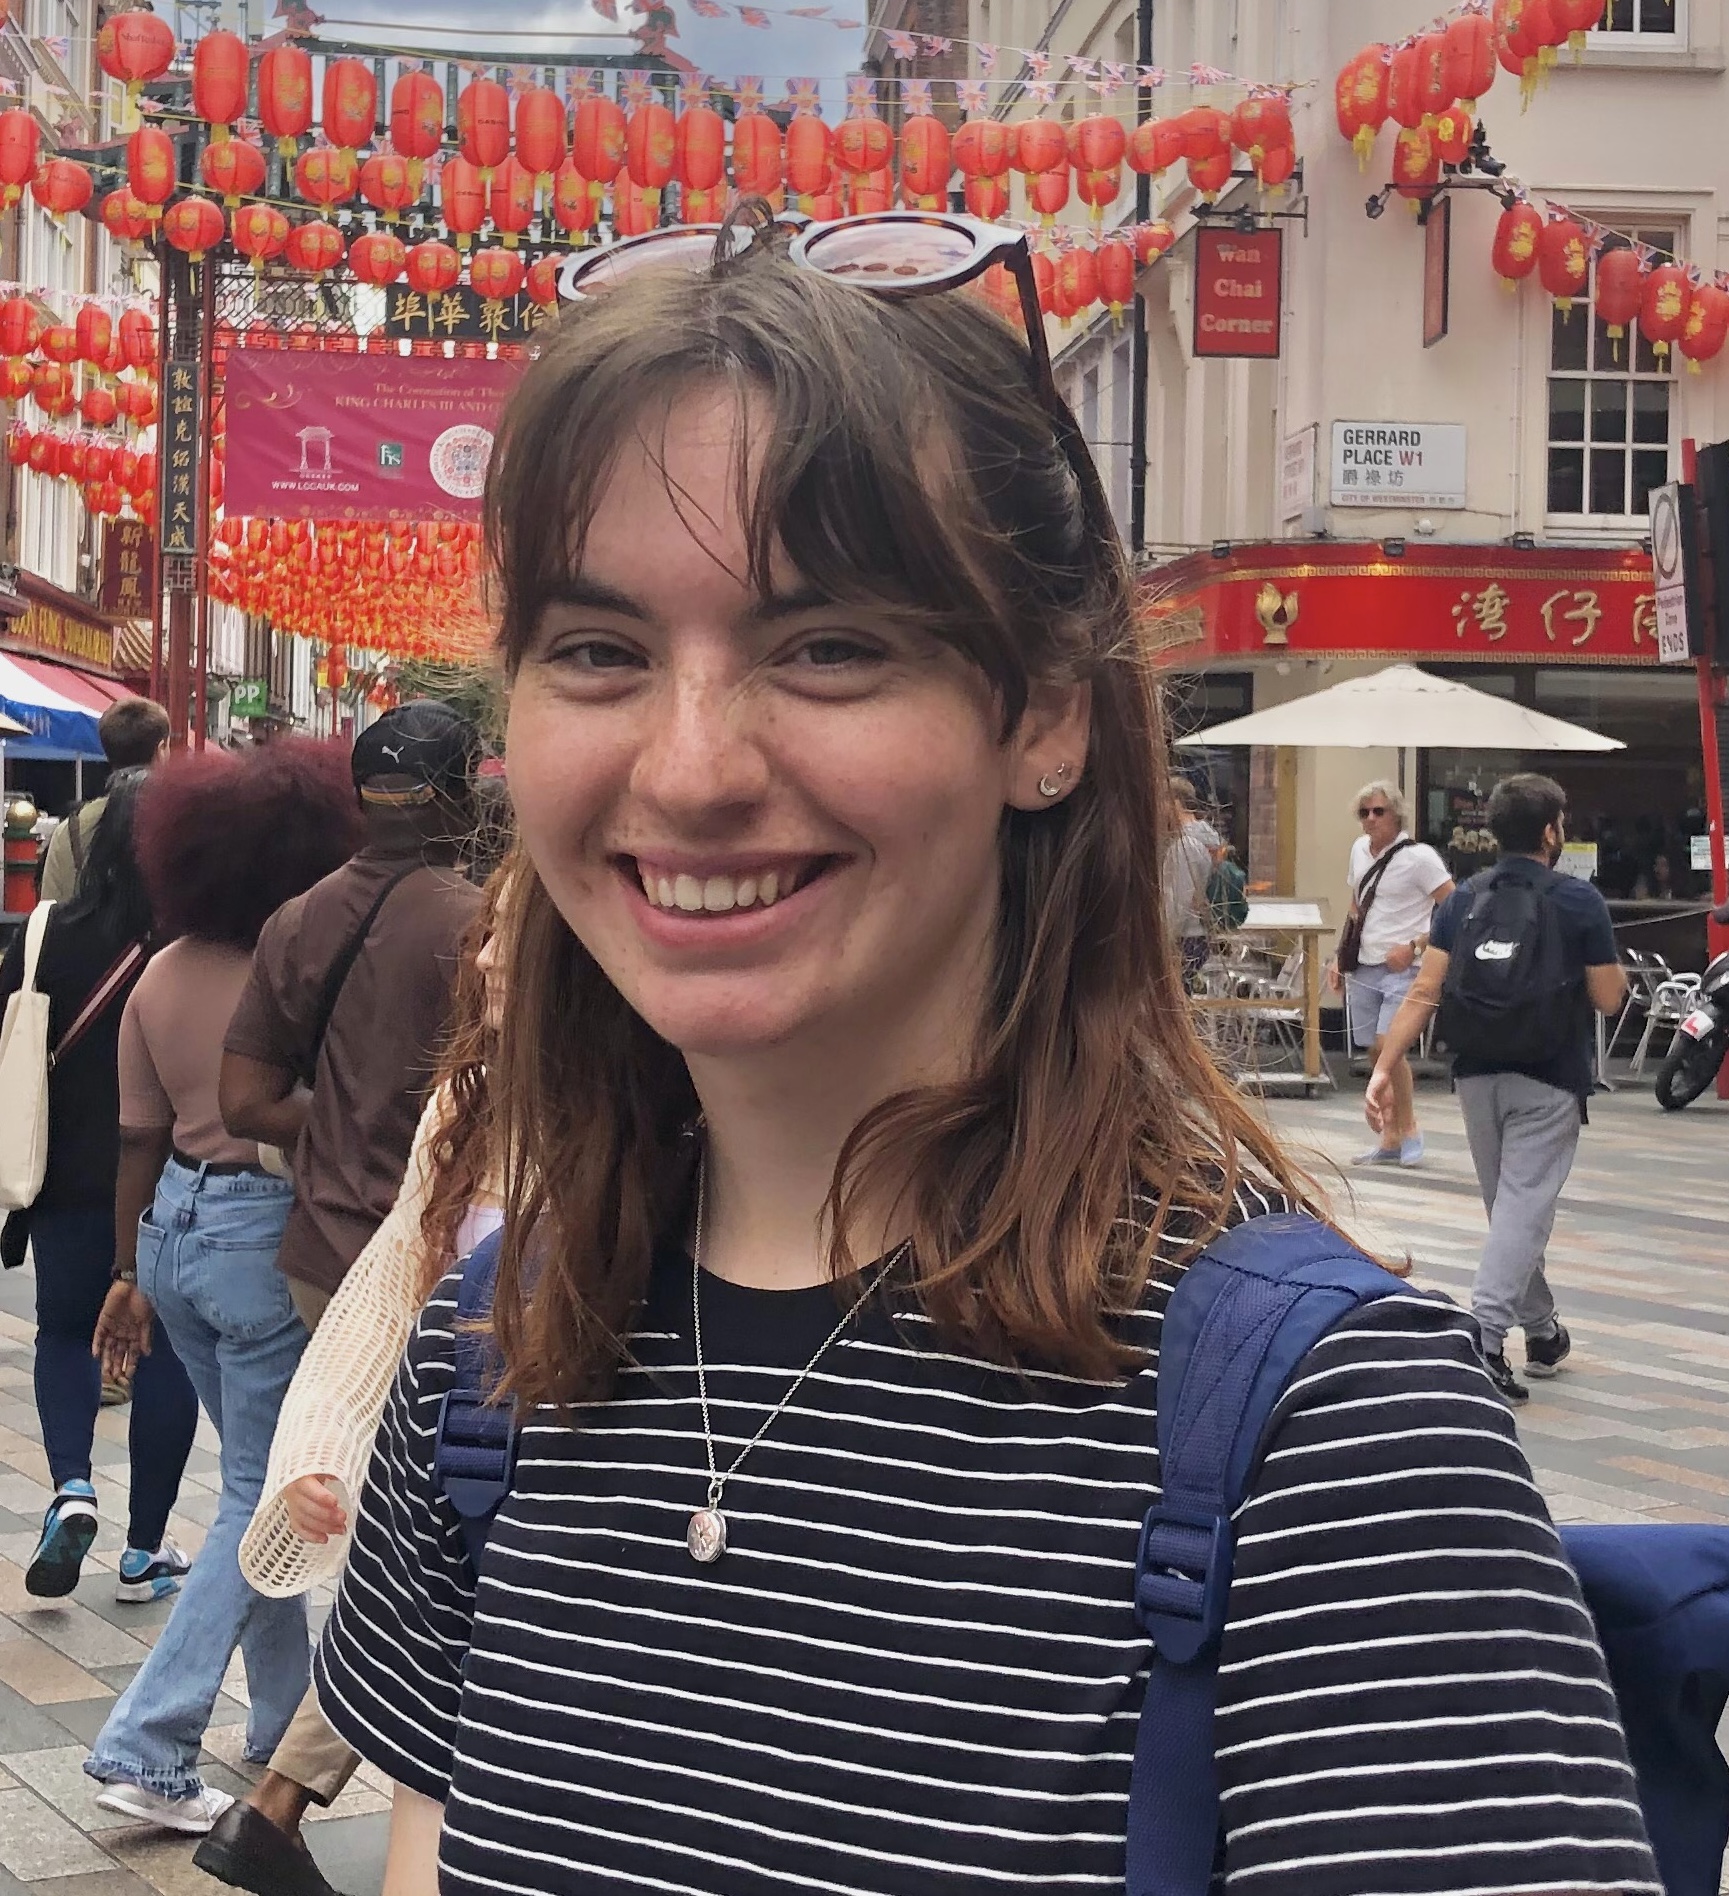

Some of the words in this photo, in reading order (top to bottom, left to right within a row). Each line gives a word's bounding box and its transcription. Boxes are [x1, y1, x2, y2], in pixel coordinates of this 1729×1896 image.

[1216, 244, 1261, 263] Wan
[1213, 278, 1262, 298] Chai
[1200, 313, 1274, 334] Corner
[374, 383, 394, 393] The
[463, 388, 475, 397] of
[335, 396, 370, 408] KING
[373, 398, 436, 410] CHARLES
[439, 401, 454, 411] III
[457, 401, 486, 412] AND
[1343, 428, 1421, 447] GERRARD
[1343, 449, 1393, 466] PLACE
[1399, 451, 1423, 467] W1
